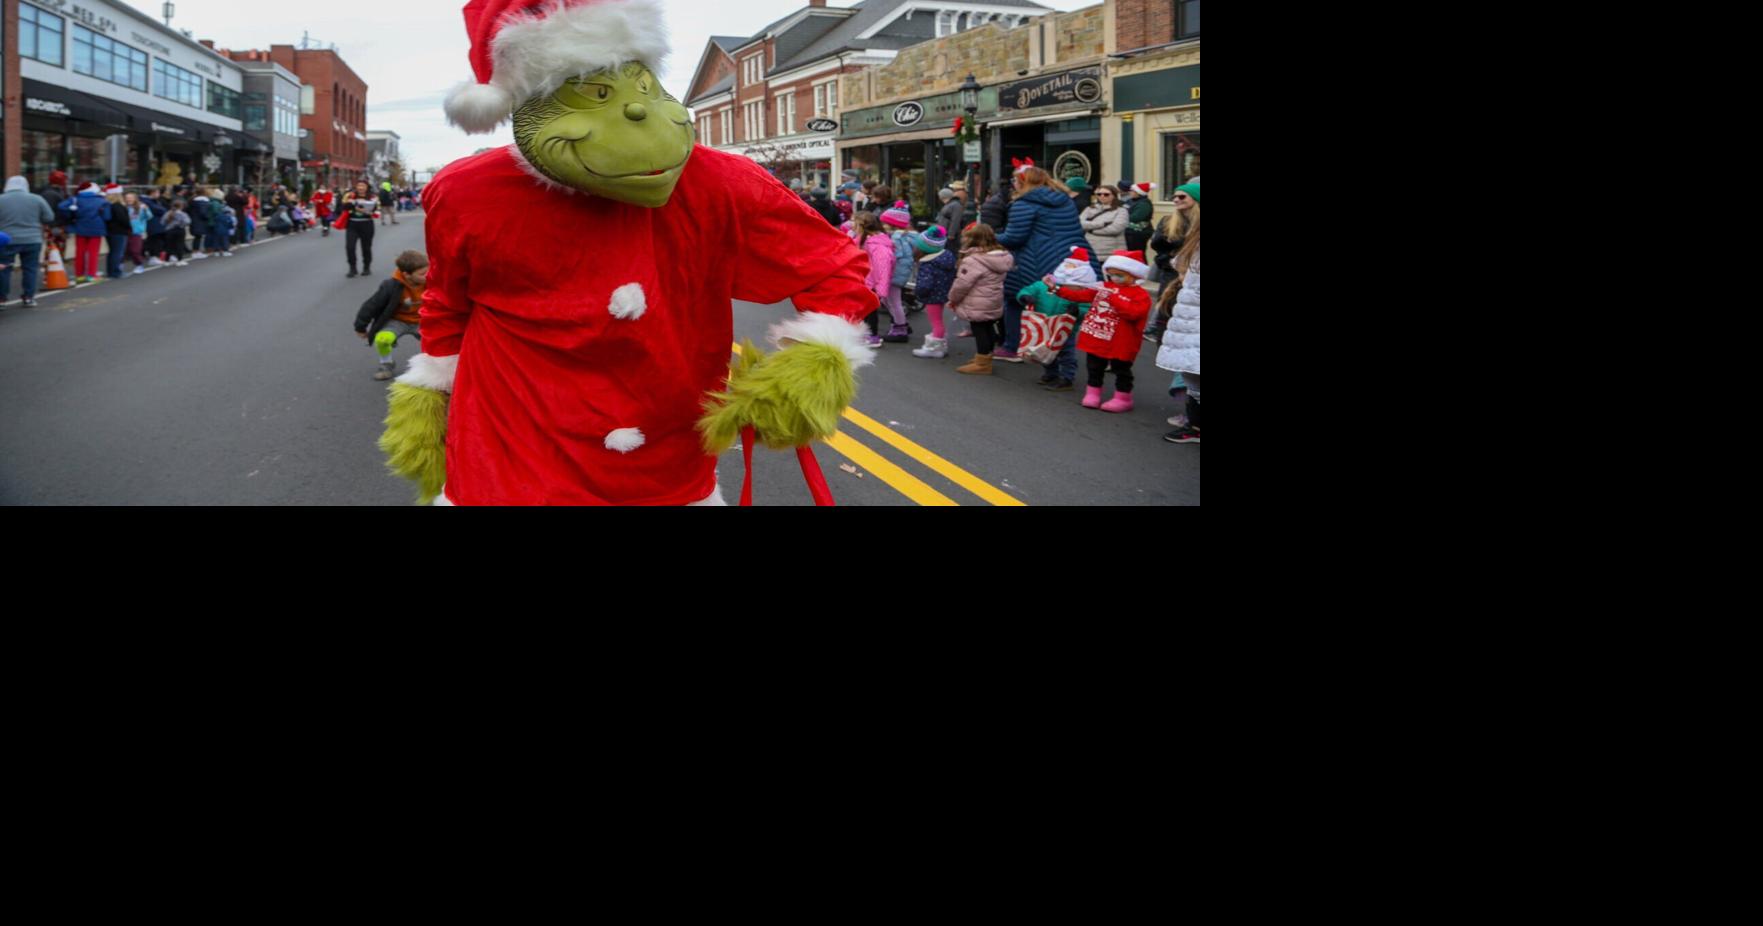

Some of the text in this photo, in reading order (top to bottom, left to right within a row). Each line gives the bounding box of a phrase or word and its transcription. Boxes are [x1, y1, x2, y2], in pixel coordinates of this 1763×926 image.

[99, 15, 118, 32] SPA
[1017, 73, 1073, 108] DOVETAIL
[895, 106, 919, 122] Chic
[810, 120, 836, 130] Chic
[808, 139, 830, 148] OPTICAL
